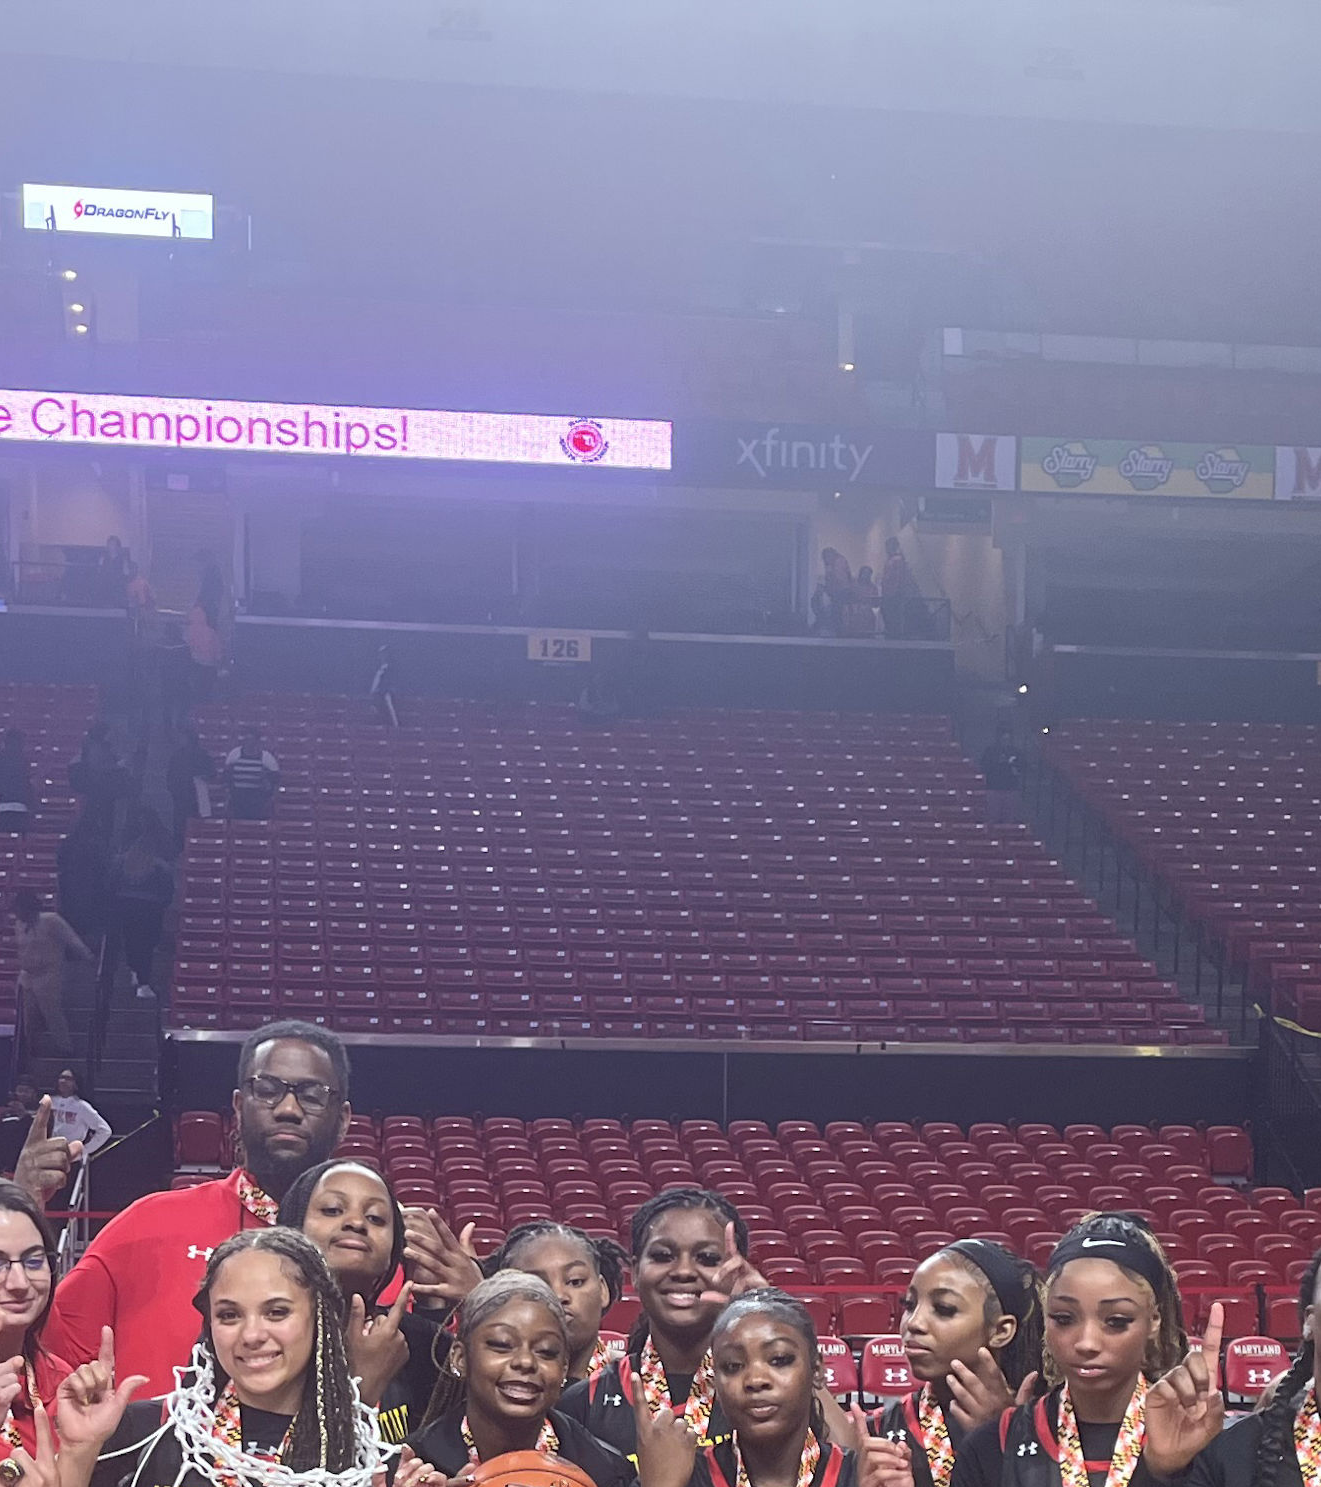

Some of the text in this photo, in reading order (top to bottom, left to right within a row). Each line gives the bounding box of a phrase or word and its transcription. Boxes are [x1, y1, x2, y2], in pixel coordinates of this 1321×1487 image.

[31, 398, 409, 455] Championships!
[736, 428, 874, 482] xfinity
[1041, 445, 1098, 480] Starry
[1118, 449, 1175, 483] Starry
[1195, 453, 1252, 486] Starry
[539, 639, 579, 658] 126
[817, 1344, 847, 1355] YLAND
[871, 1343, 905, 1355] MARYL
[1233, 1344, 1282, 1355] MARYLAND
